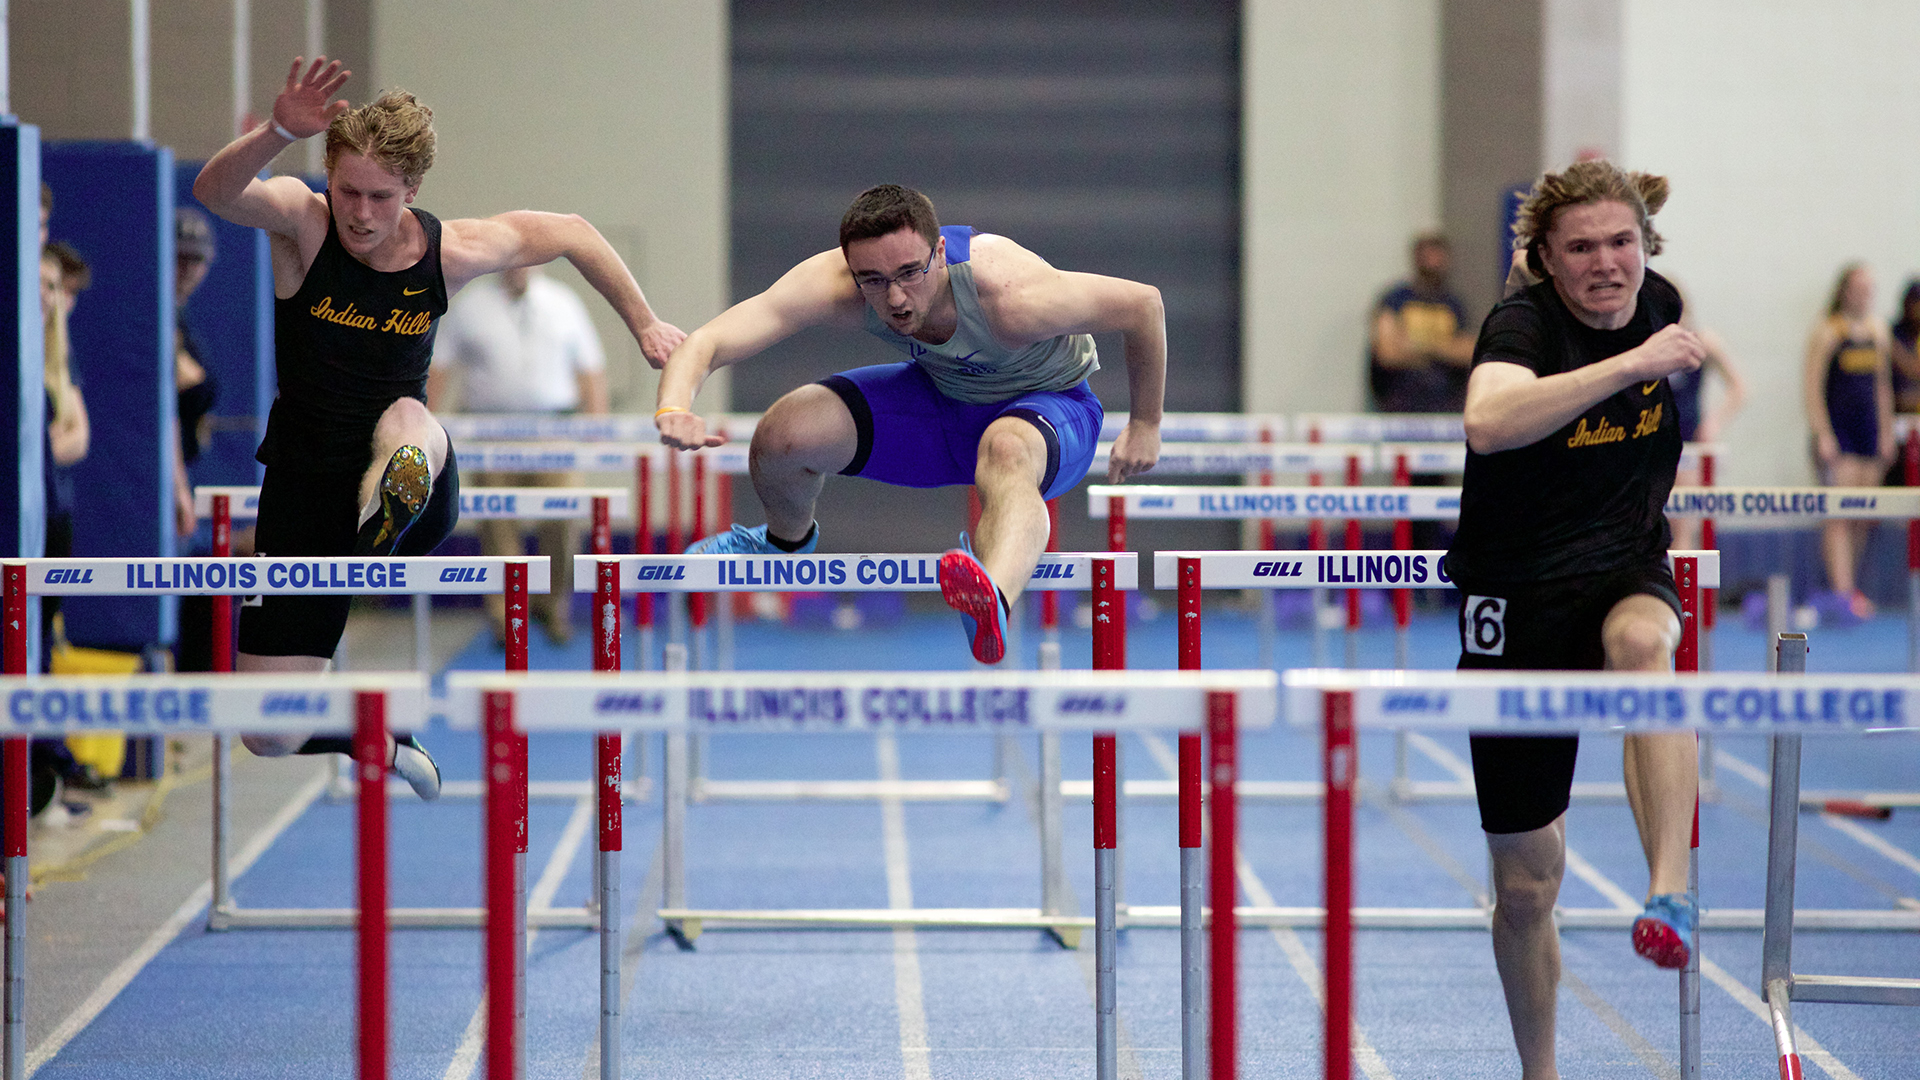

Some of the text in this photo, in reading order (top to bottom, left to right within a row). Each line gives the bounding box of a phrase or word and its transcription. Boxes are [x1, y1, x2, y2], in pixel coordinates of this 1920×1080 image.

[310, 296, 431, 335] Indian Hills
[1567, 416, 1626, 448] Indian
[459, 495, 516, 513] LEGE
[1200, 494, 1410, 512] ILLINOIS COLLEGE
[1742, 493, 1828, 513] COLLEGE
[44, 562, 488, 588] GILL ILLINOIS COLLEGE GILL
[637, 559, 1075, 585] GILL ILLINOIS COLL GILL
[1252, 561, 1303, 577] GILL
[1318, 555, 1428, 583] ILLINOIS
[1473, 599, 1502, 650] 6
[8, 688, 212, 725] COLLEGE
[1497, 687, 1905, 724] ILLINOIS COLLEGE
